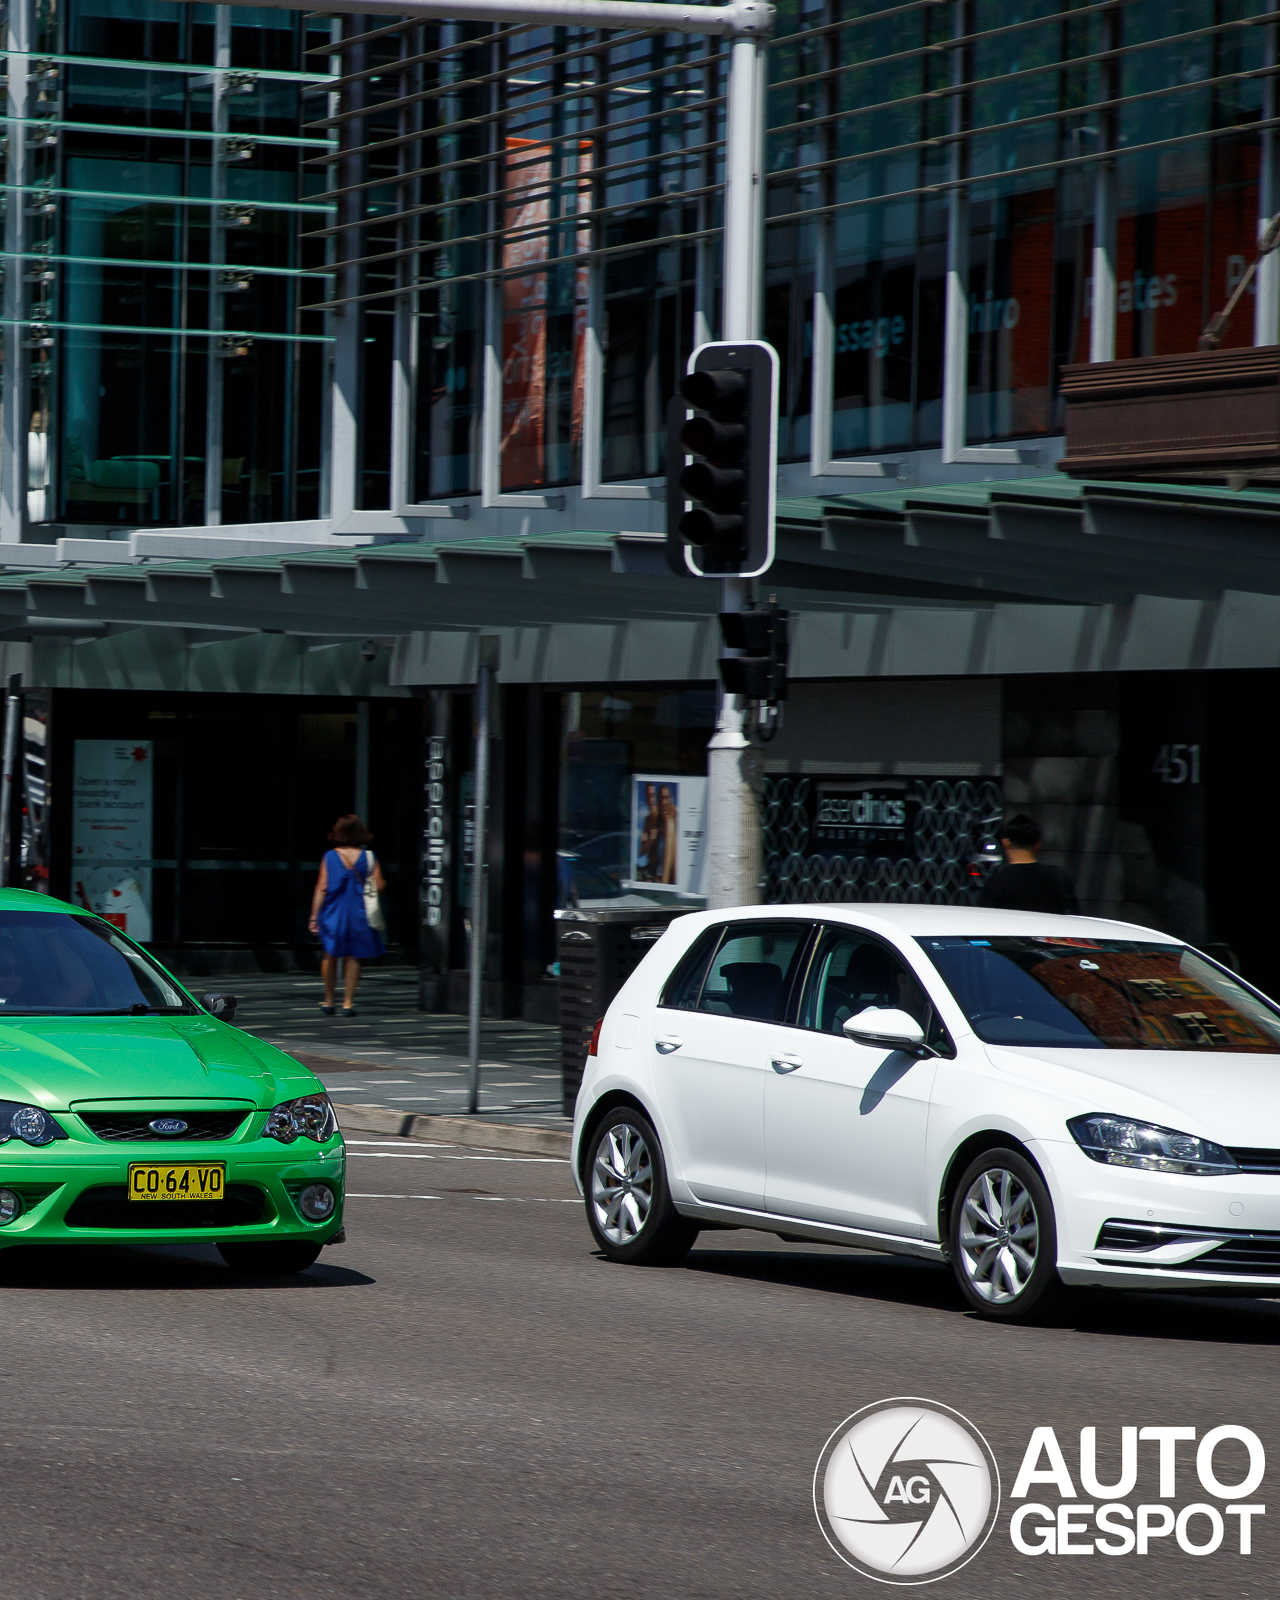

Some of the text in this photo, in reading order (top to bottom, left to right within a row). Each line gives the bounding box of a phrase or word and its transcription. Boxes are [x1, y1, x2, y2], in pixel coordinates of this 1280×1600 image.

[1083, 269, 1178, 318] ates
[804, 314, 906, 358] ssage
[1151, 743, 1202, 784] 451
[158, 1120, 180, 1131] Ford
